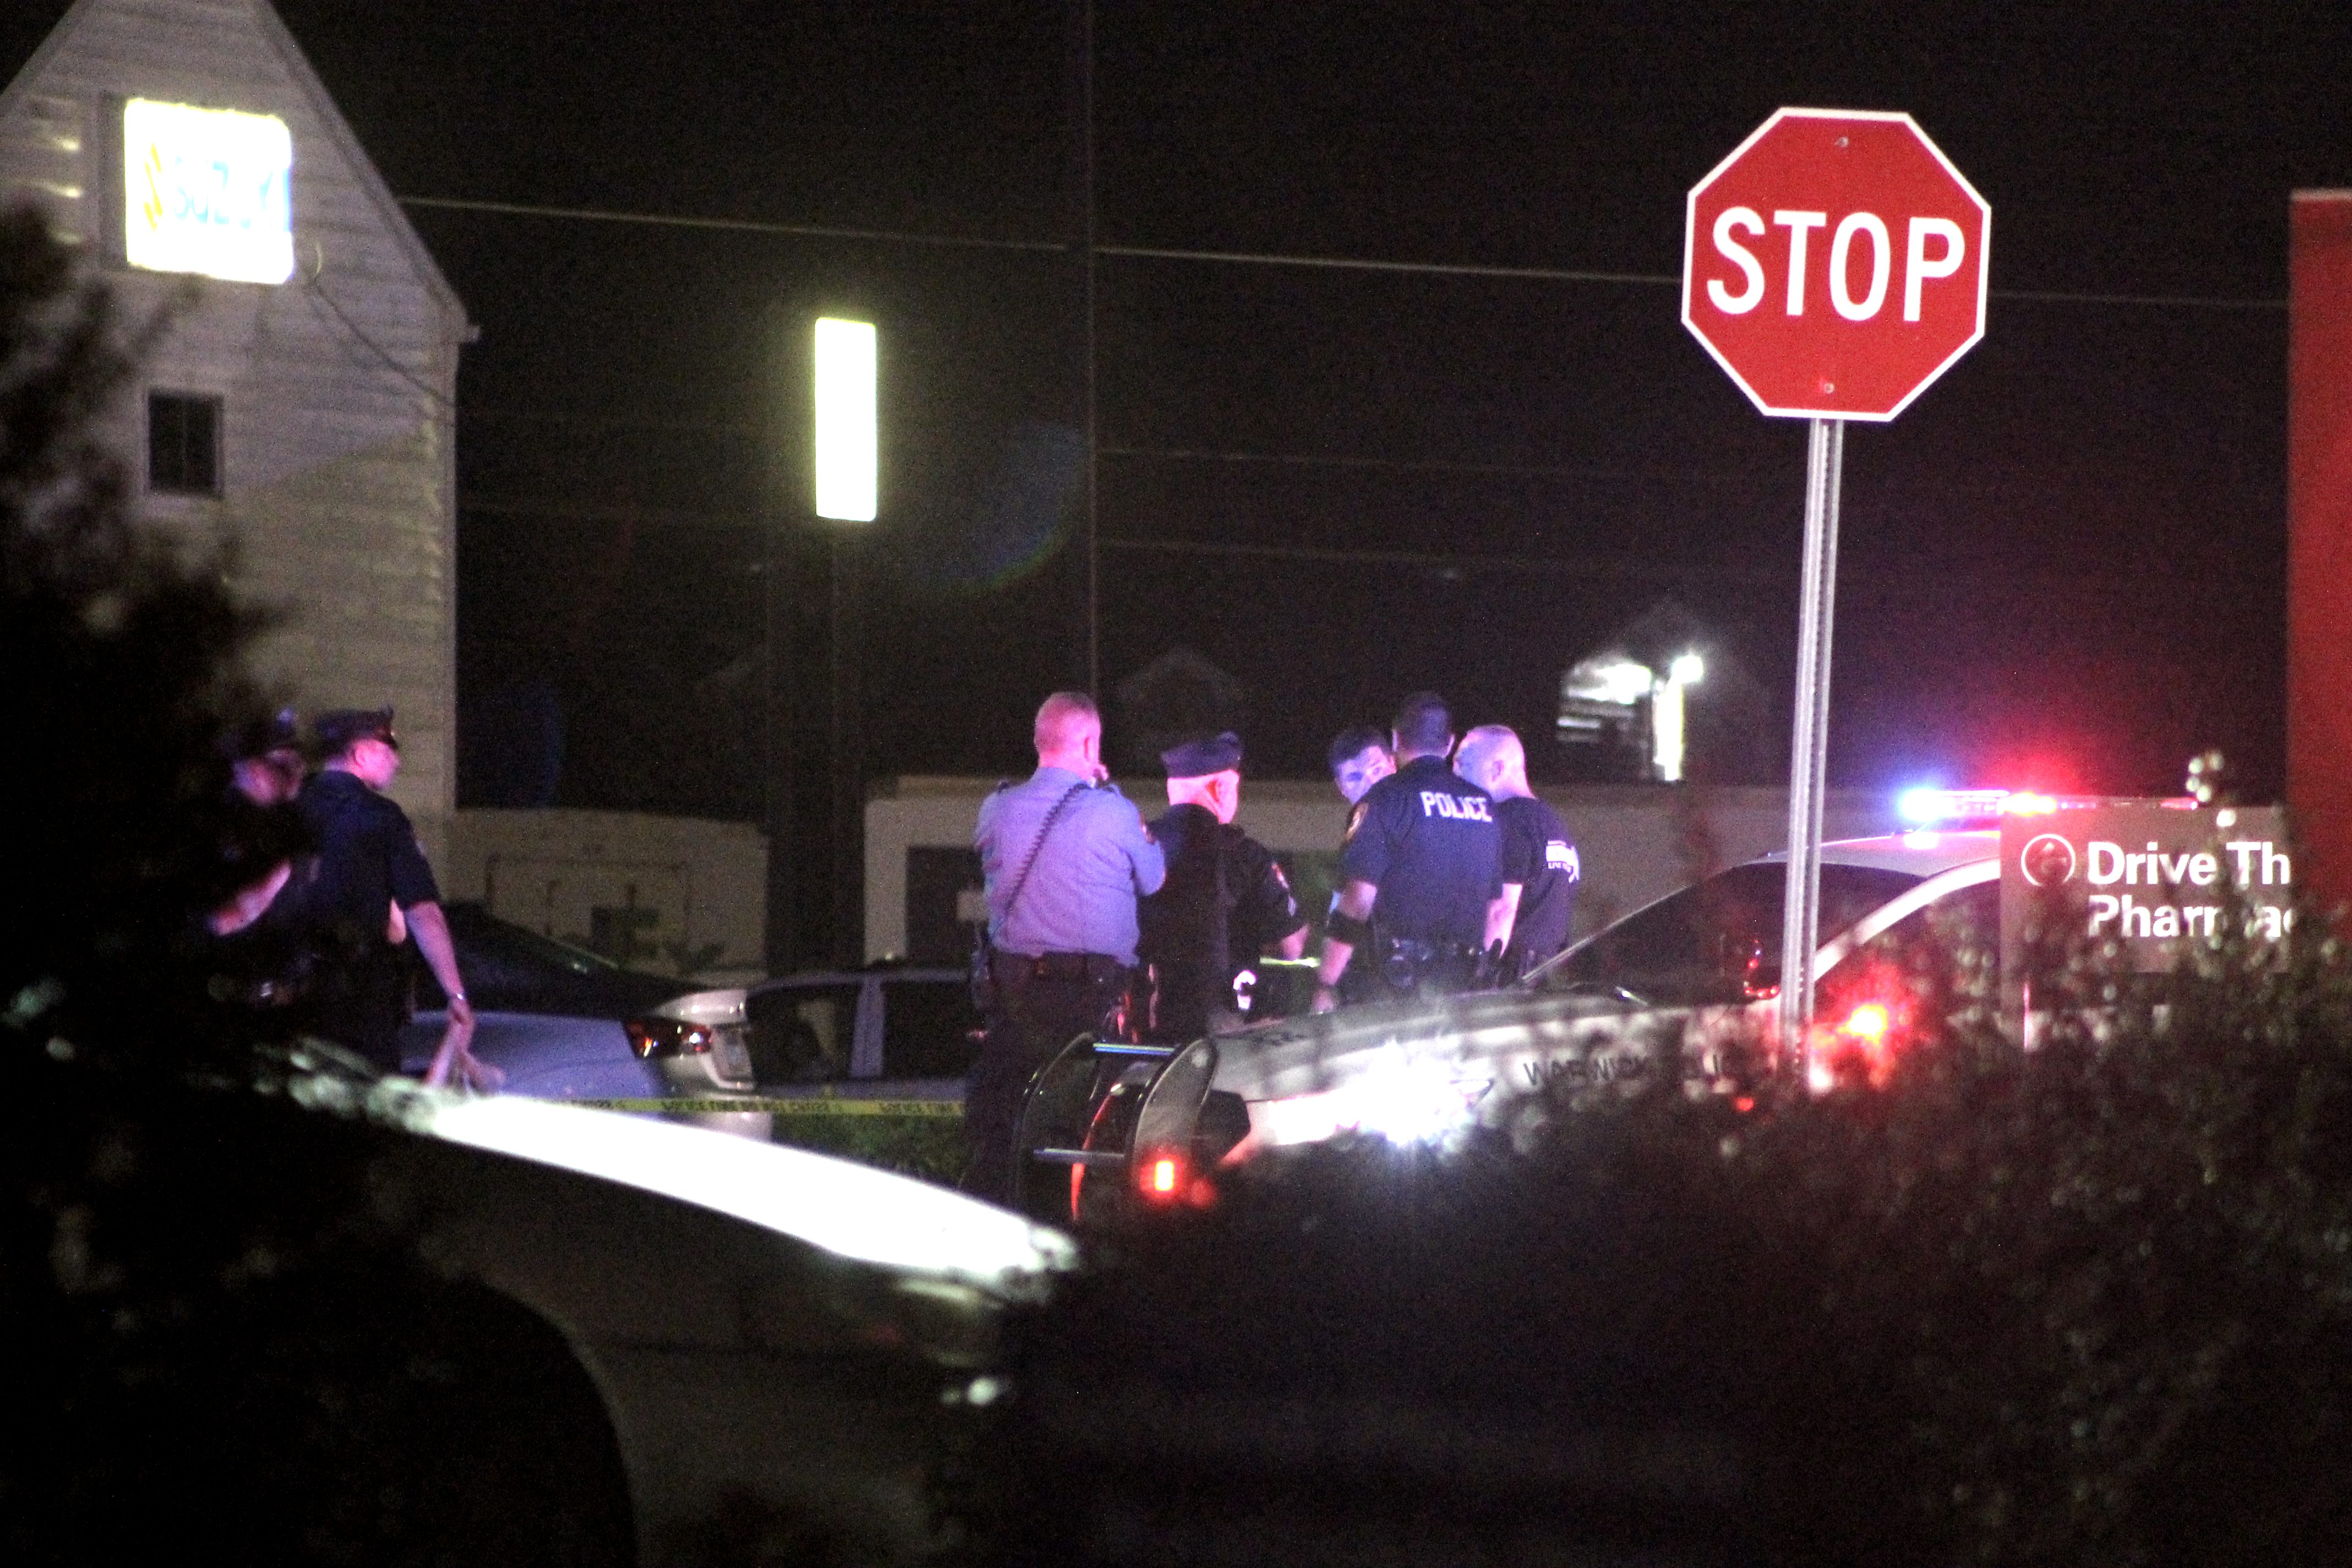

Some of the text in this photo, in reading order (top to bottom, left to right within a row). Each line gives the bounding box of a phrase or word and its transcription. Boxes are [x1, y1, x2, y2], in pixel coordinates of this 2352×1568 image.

[1707, 207, 1965, 322] STOP
[1420, 791, 1493, 823] POLICE
[2088, 842, 2217, 885] Drive
